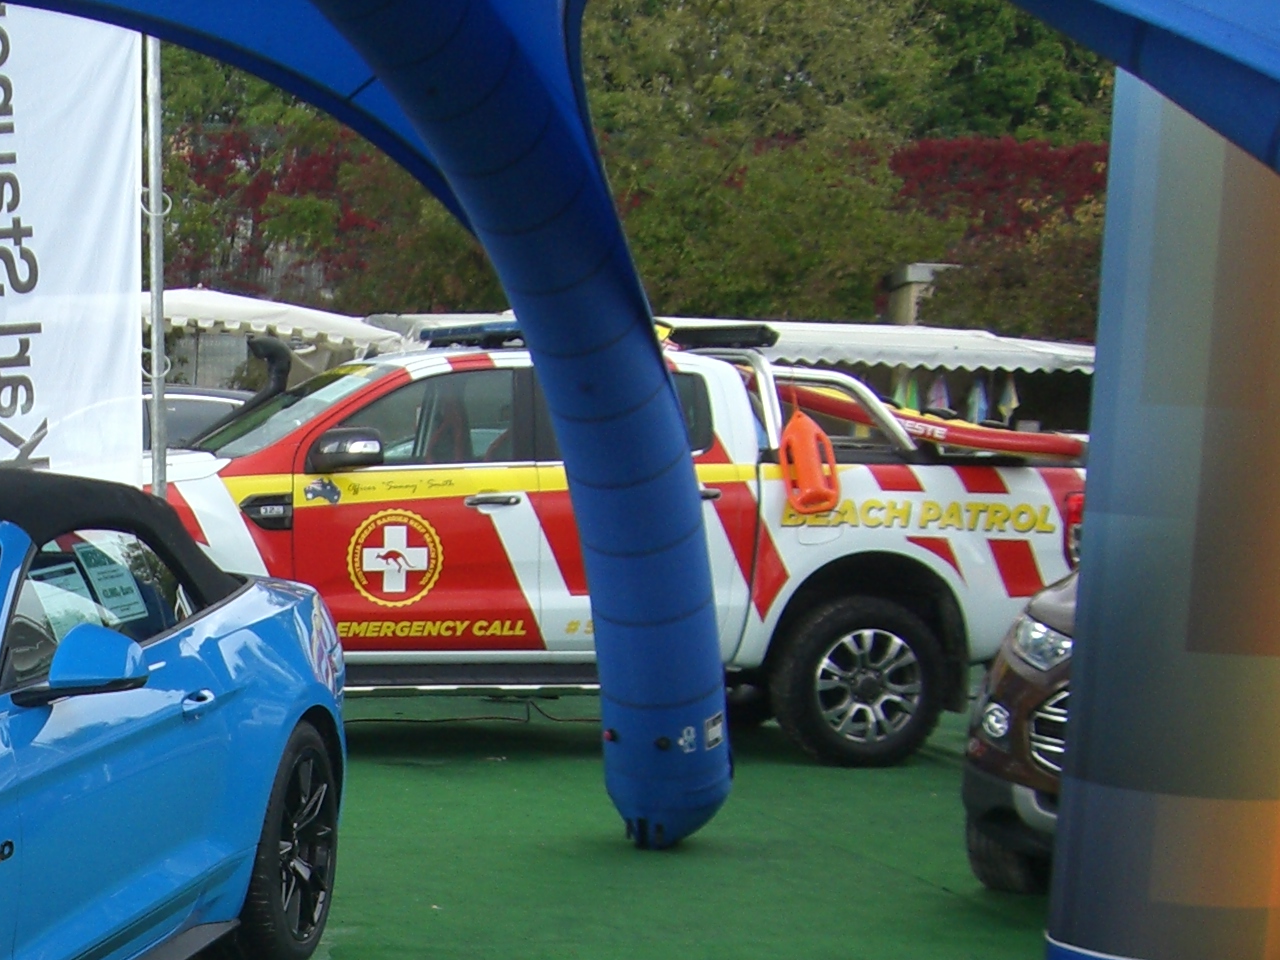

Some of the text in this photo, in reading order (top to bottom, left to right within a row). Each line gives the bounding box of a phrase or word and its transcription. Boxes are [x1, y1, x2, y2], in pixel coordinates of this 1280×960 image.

[918, 500, 1057, 534] PATROL
[336, 619, 527, 639] EMERGENCY CALL
